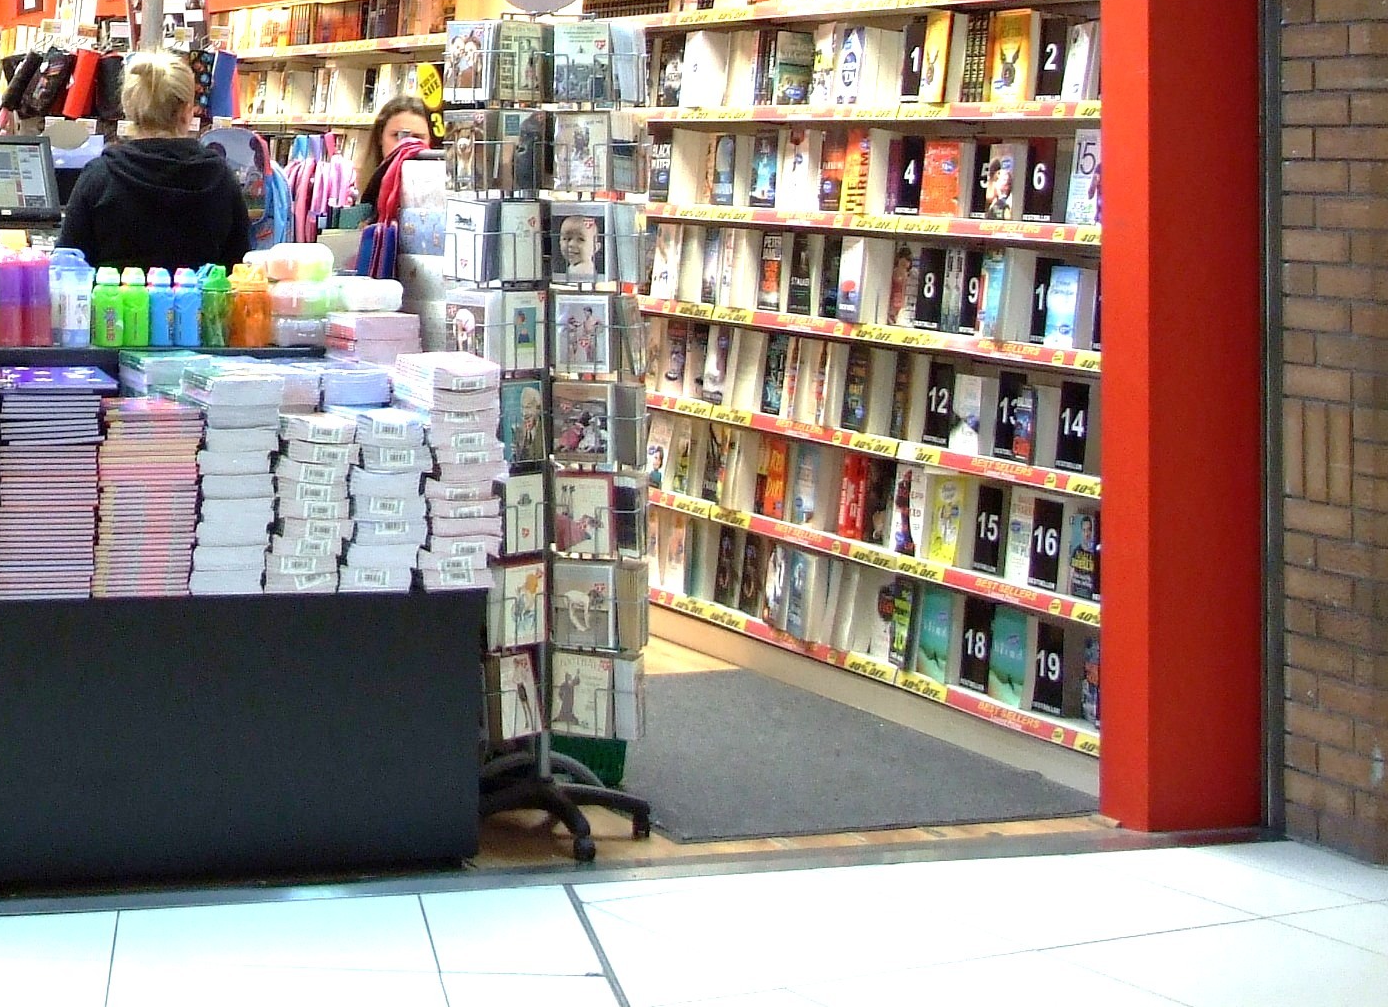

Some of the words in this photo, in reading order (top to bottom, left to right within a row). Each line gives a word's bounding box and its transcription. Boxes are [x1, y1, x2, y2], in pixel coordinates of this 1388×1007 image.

[910, 47, 920, 72] 1
[1043, 43, 1058, 70] 2
[431, 113, 445, 137] 3
[903, 159, 915, 184] 4
[1075, 142, 1096, 175] 15
[1033, 163, 1046, 190] 6
[923, 273, 935, 298] 8
[968, 277, 979, 303] 9
[1035, 283, 1044, 310] 1
[928, 386, 948, 414] 12
[1060, 407, 1084, 437] 14
[977, 511, 999, 541] 15
[1034, 525, 1058, 556] 16
[975, 578, 998, 590] BEST
[999, 583, 1037, 600] SELLERS
[964, 628, 986, 659] 18
[1036, 649, 1060, 681] 19
[977, 701, 1000, 716] BEST
[1001, 709, 1040, 728] SELLERS
